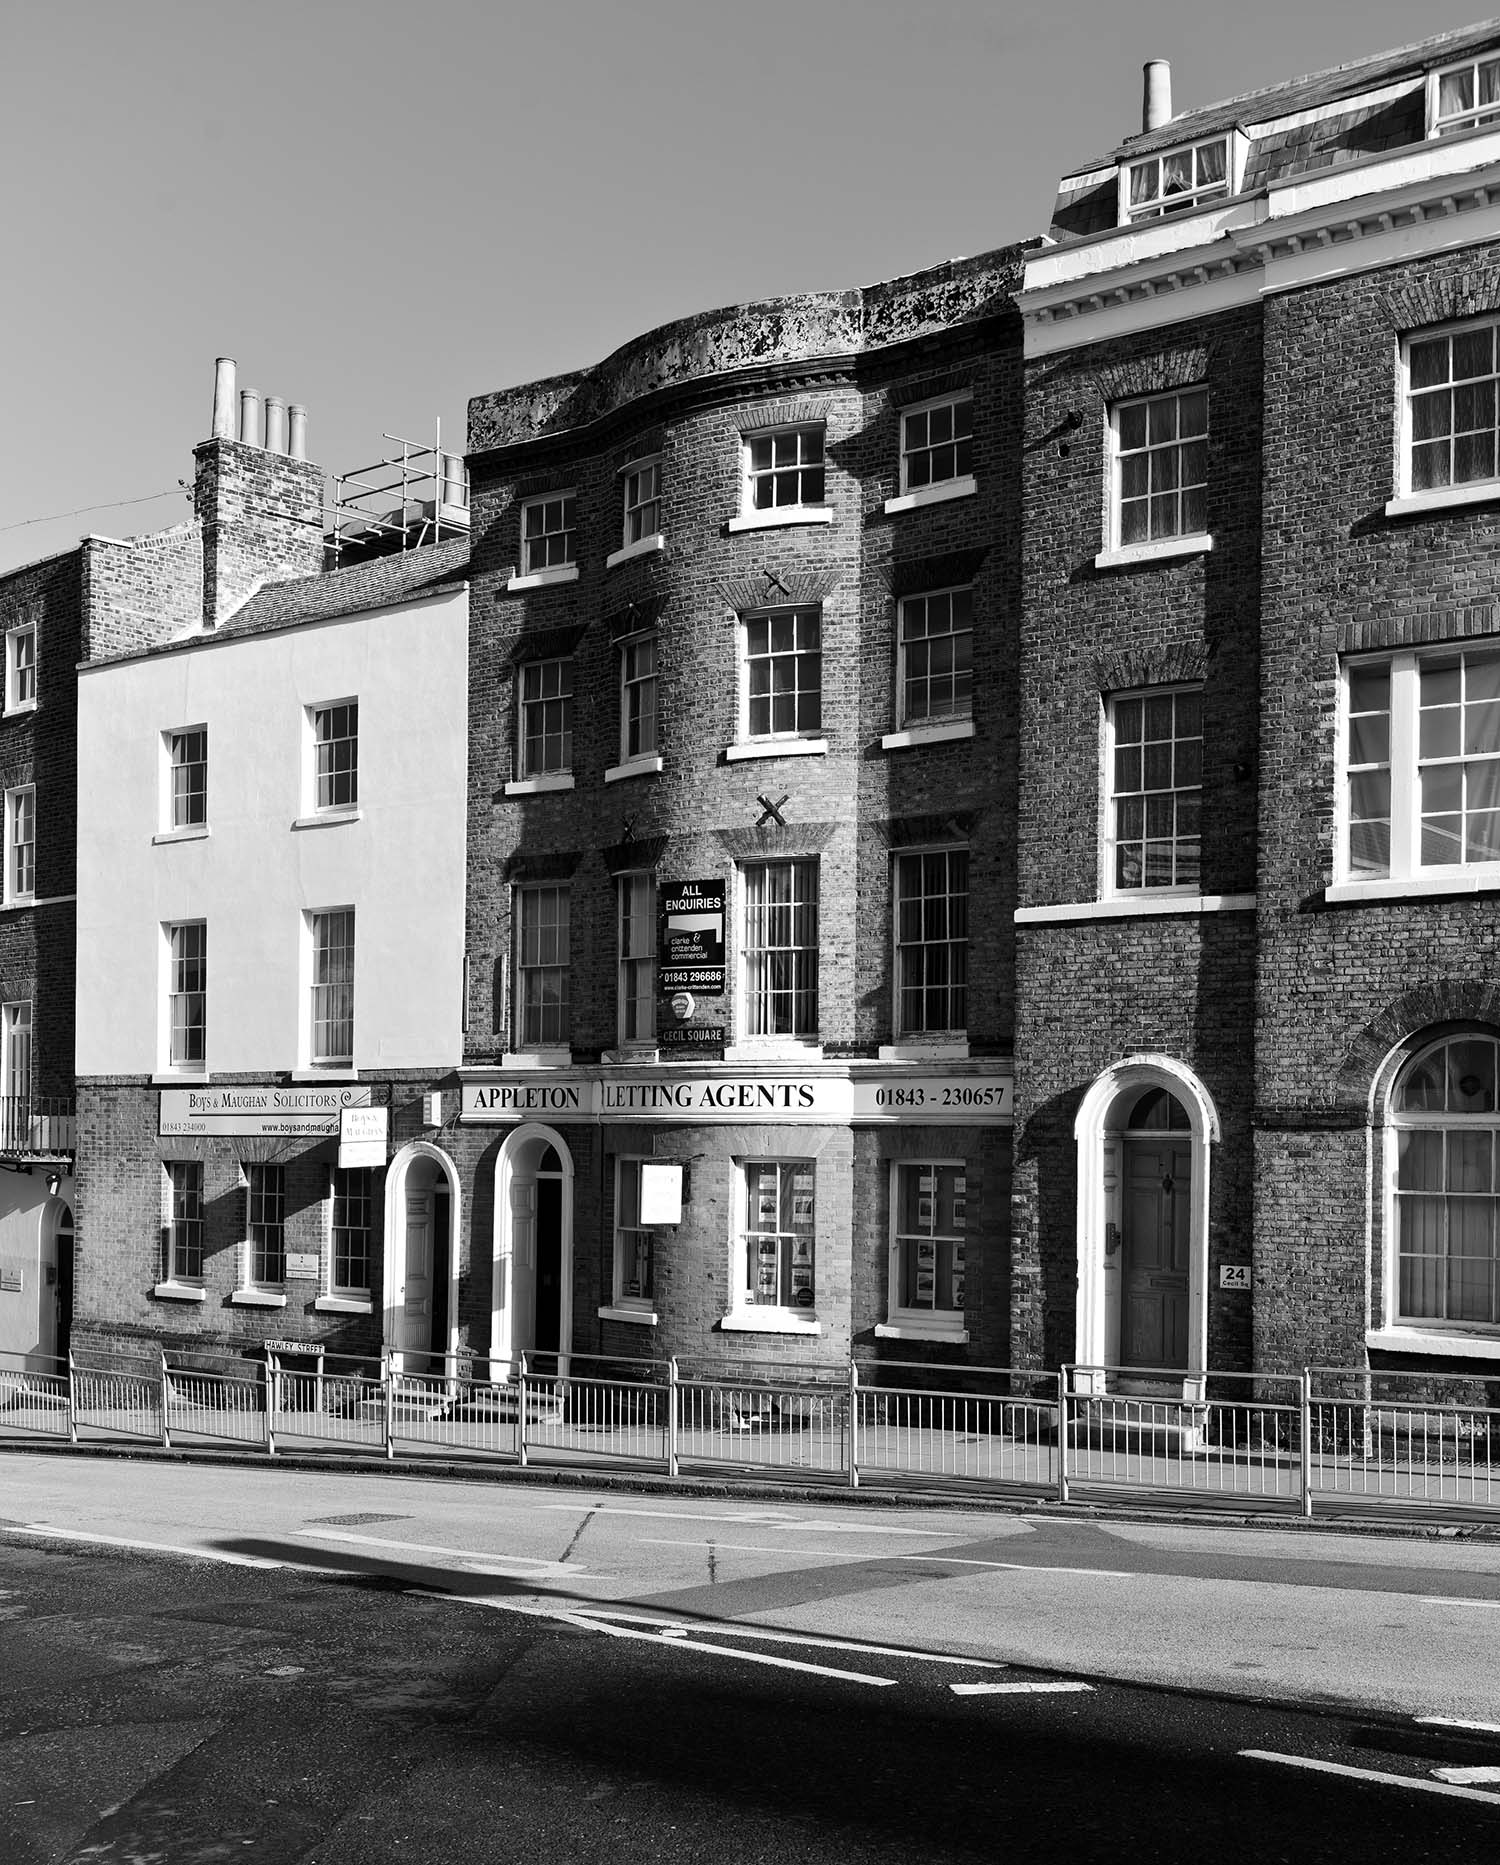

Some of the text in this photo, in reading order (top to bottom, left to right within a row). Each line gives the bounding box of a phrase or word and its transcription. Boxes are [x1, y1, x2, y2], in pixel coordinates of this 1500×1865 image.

[682, 885, 702, 896] ALL
[665, 897, 721, 911] ENQUIRIES
[693, 932, 701, 943] &
[671, 951, 708, 960] commercial
[664, 971, 722, 982] 01843 296686
[663, 1029, 722, 1041] CECIL SQUARE
[213, 1098, 219, 1108] &
[221, 1093, 268, 1108] MAUGHAN
[273, 1092, 337, 1108] SOLICITORS
[473, 1083, 815, 1109] APPLETON LETTING AGENTS
[875, 1087, 925, 1107] 01843
[942, 1086, 1005, 1107] 230657
[162, 1122, 181, 1132] 01843
[262, 1123, 339, 1134] www.boysandmaugha
[1225, 1267, 1246, 1280] 24
[265, 1340, 324, 1354] HAWLEY STREET
